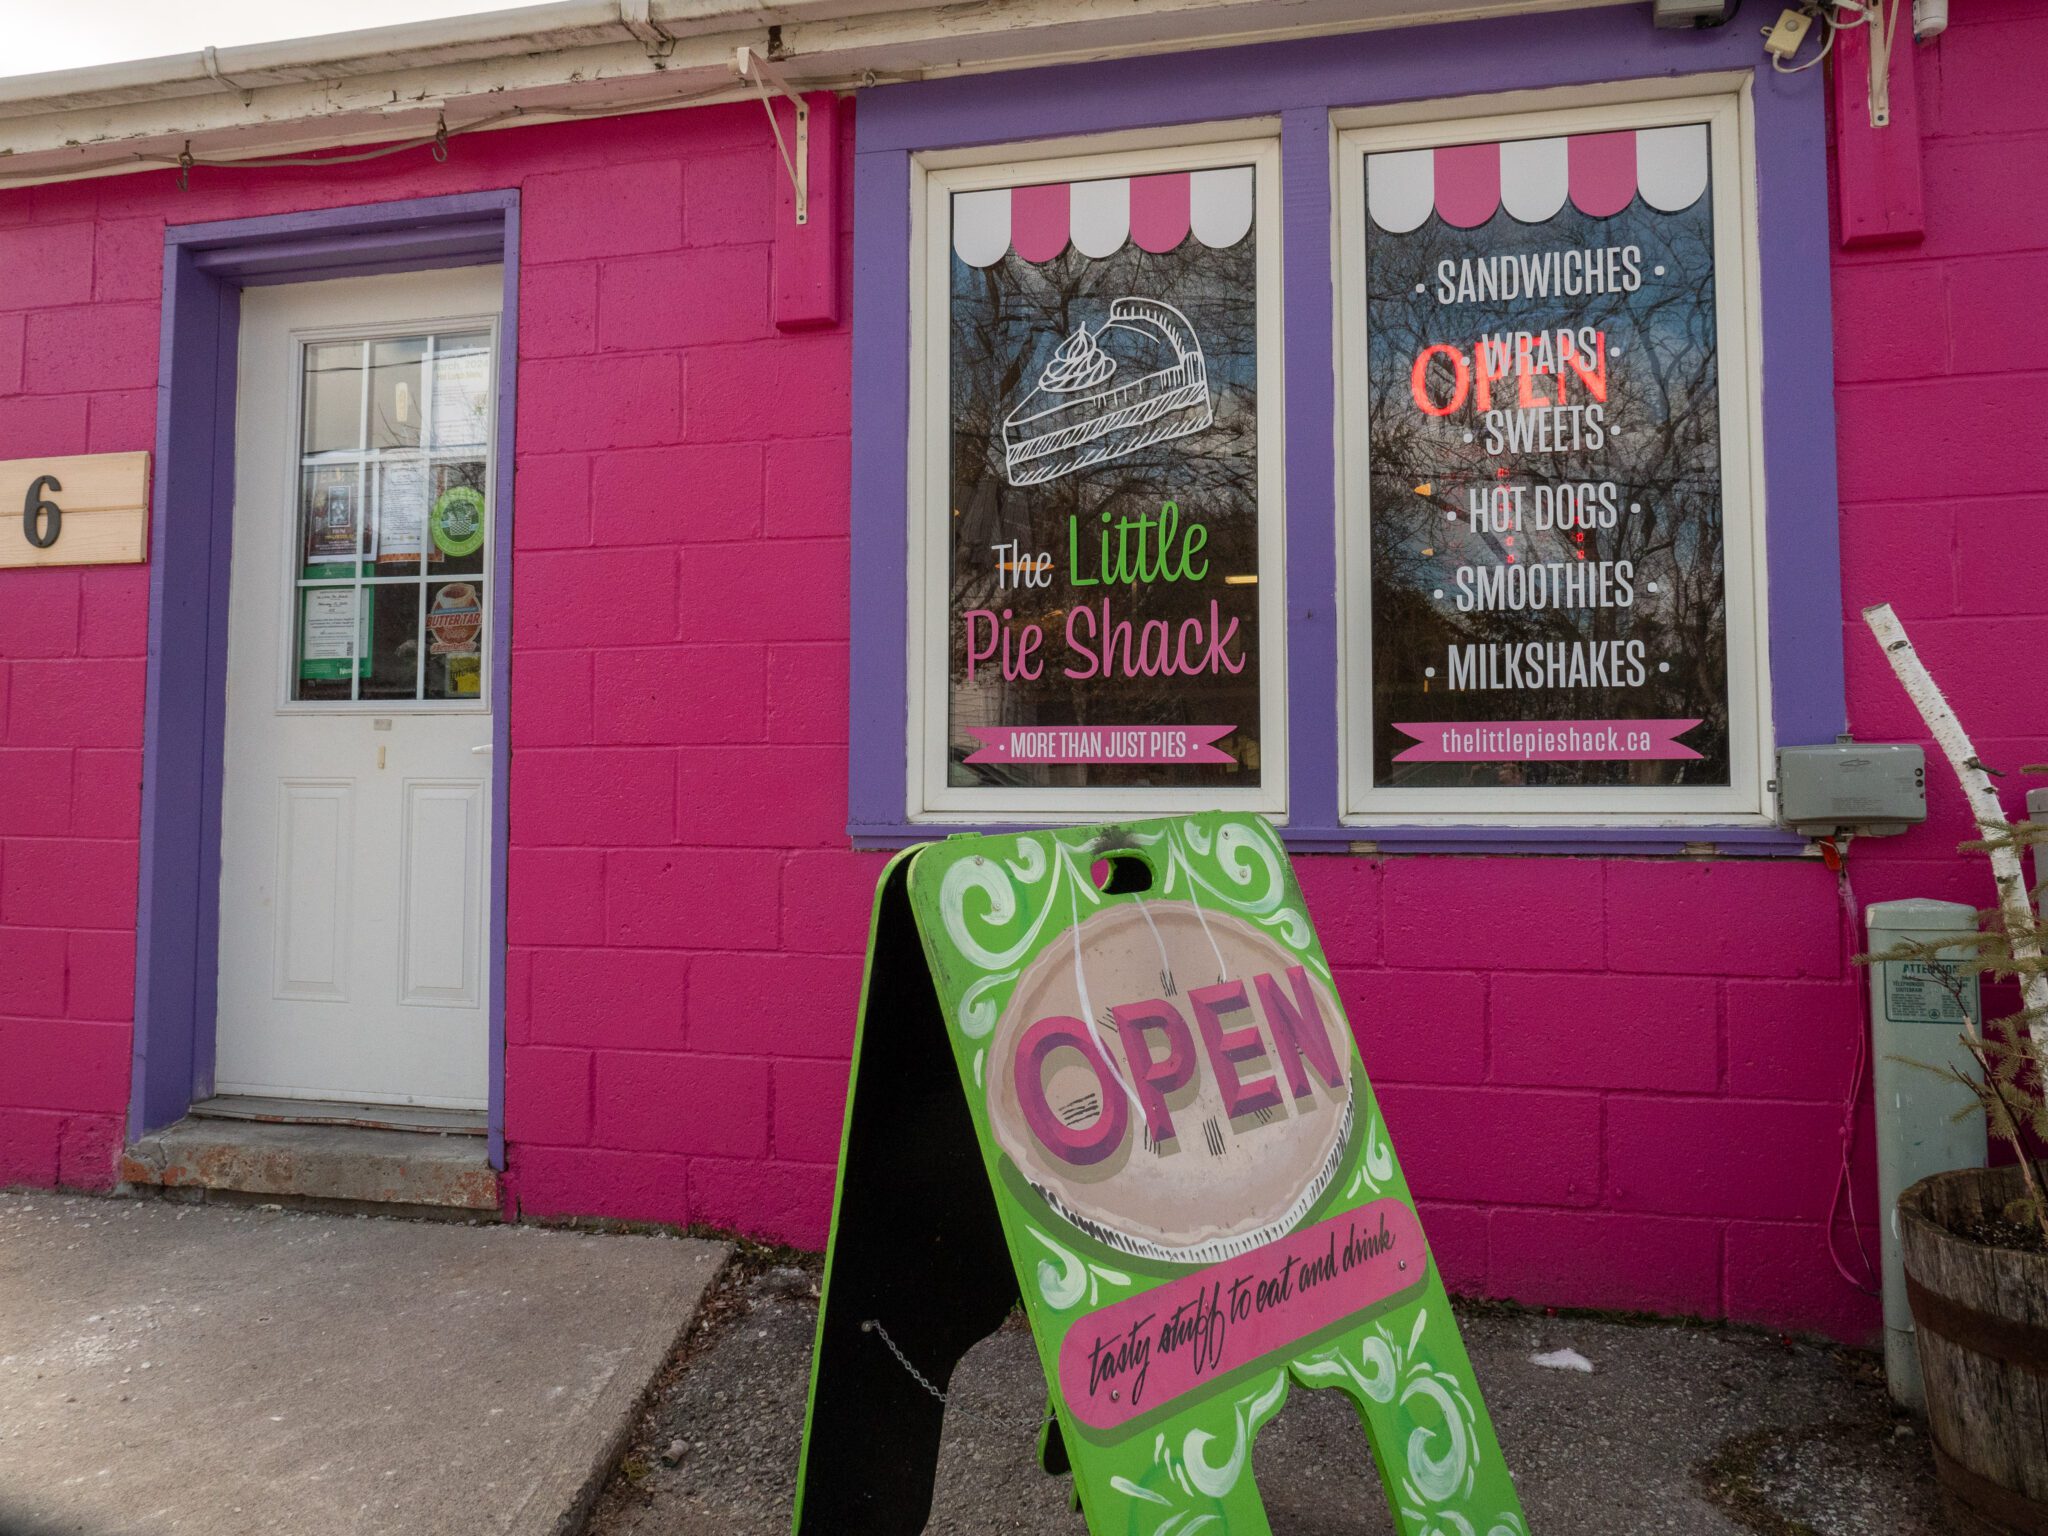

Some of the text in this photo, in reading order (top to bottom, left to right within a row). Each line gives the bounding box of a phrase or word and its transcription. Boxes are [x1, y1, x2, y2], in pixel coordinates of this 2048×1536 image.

[1438, 245, 1642, 305] SANDWICHES
[1411, 331, 1608, 417] OPEN
[1482, 326, 1598, 377] WRAPS
[1485, 404, 1604, 455] SWEETS
[23, 475, 62, 548] 6
[1470, 481, 1617, 533] HOT DOGS
[991, 500, 1209, 589] The Little
[1455, 560, 1634, 612] SMOOTHIES
[426, 612, 481, 628] BUTTER TAR
[963, 597, 1246, 683] Pie Shack
[1448, 639, 1646, 690] MILKSHAKES
[1010, 731, 1186, 758] MORE THAN JUST PIES
[1442, 726, 1651, 759] thelittlepieshack.ca
[1013, 964, 1345, 1167] OPEN
[1088, 1212, 1396, 1405] tasty stuff to eat and drink
